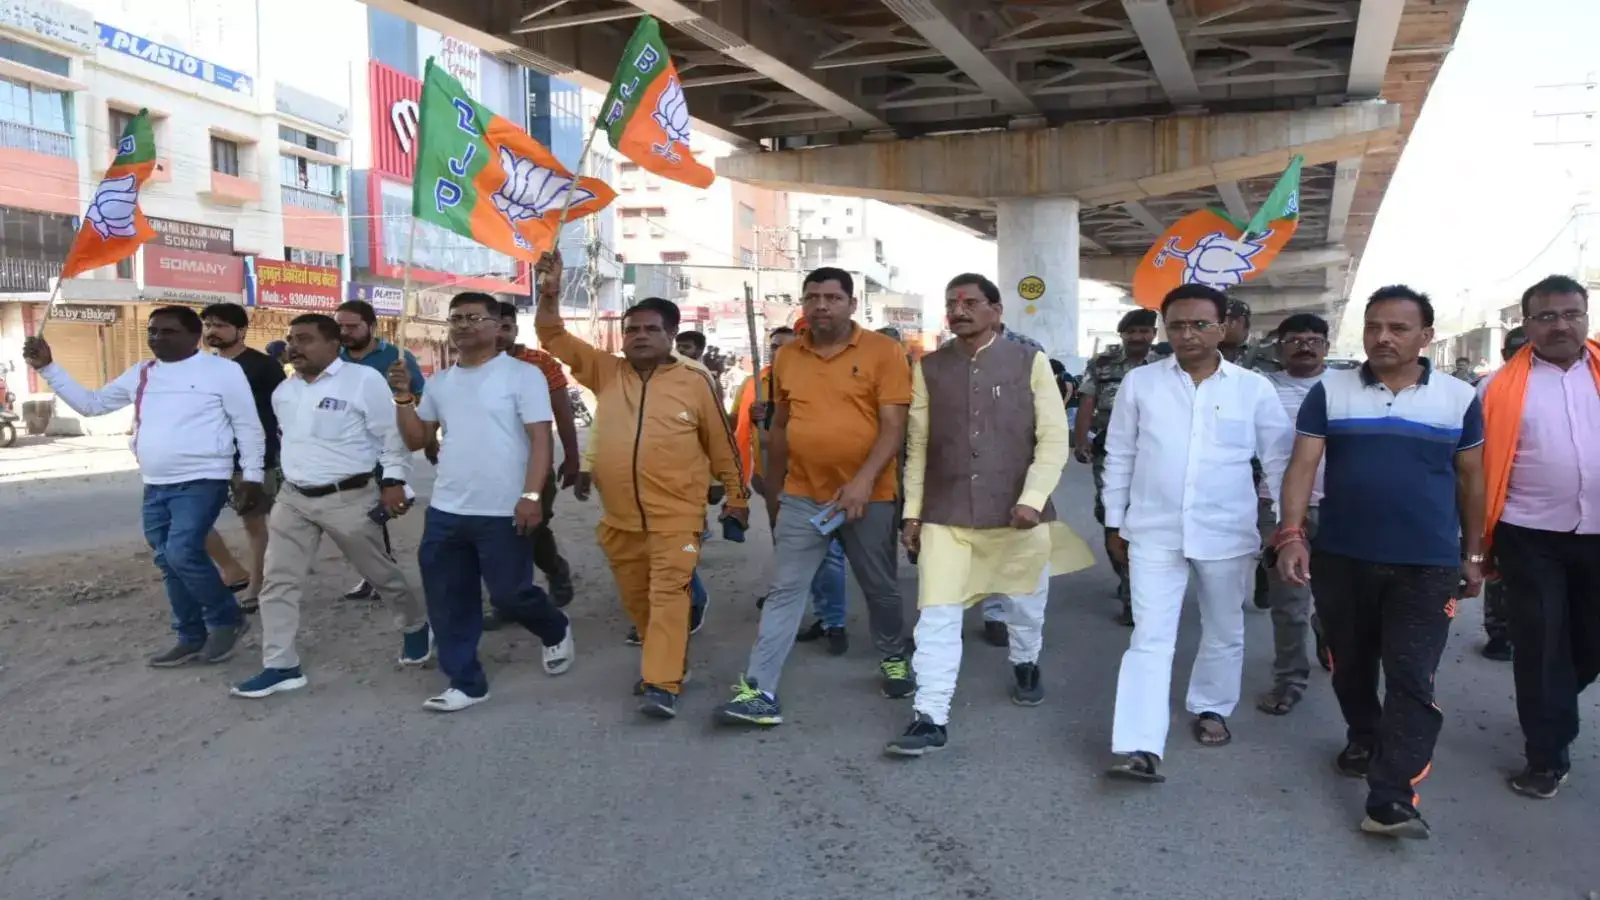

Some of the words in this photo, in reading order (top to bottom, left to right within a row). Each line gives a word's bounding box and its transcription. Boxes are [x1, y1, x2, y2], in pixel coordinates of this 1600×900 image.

[111, 31, 198, 74] PLASTO
[164, 235, 208, 249] SOMANY
[160, 257, 227, 276] SOMANY
[1021, 283, 1042, 293] R82
[289, 292, 336, 308] 9304007912
